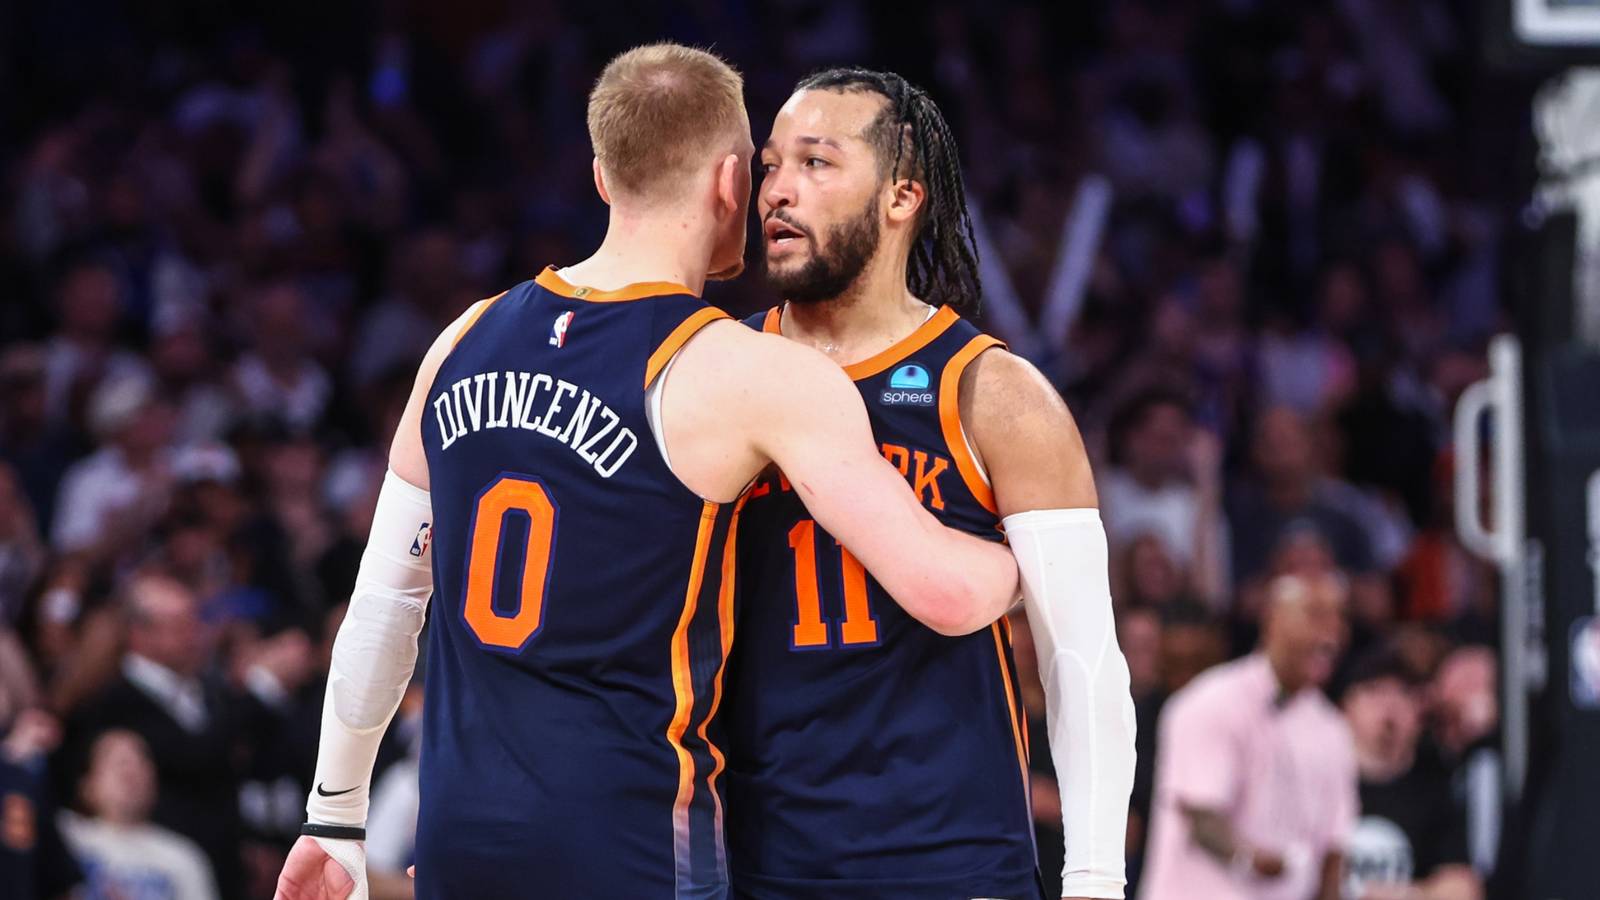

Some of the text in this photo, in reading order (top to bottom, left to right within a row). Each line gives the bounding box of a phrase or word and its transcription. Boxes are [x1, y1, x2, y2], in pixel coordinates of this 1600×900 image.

[434, 371, 637, 478] DIVINCENZO
[883, 391, 933, 404] sphere
[463, 475, 557, 651] 0
[788, 519, 879, 647] 11
